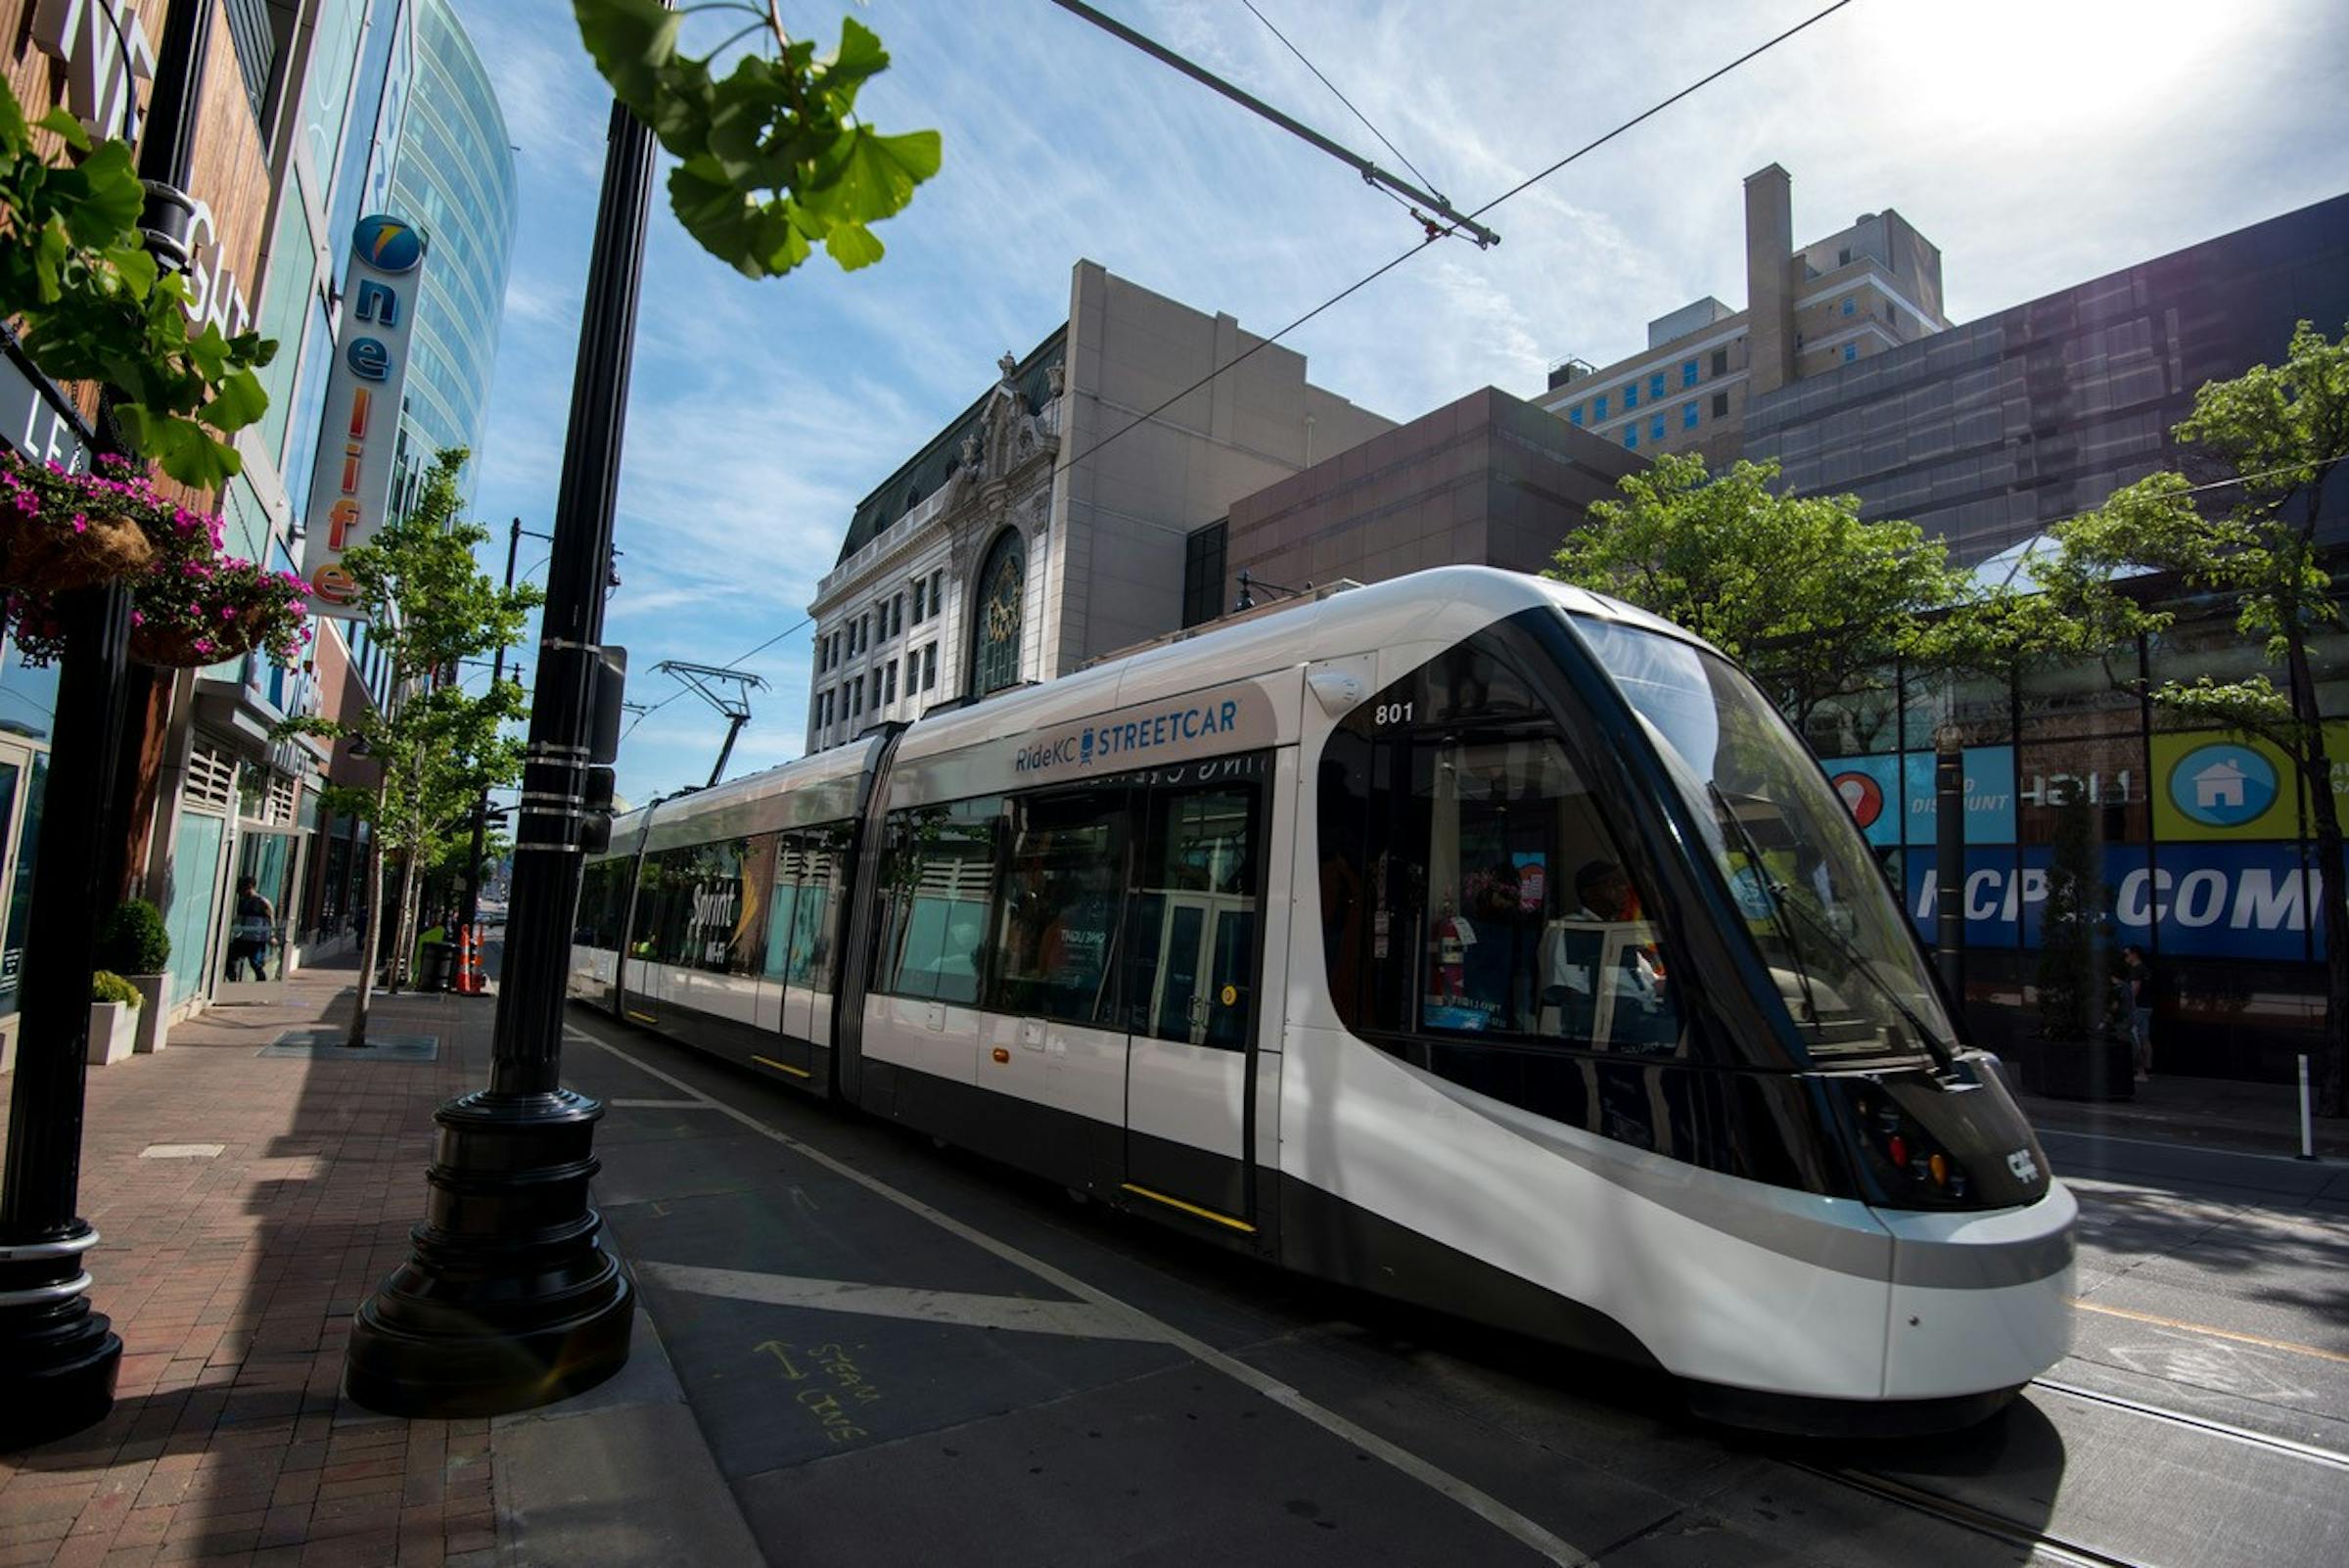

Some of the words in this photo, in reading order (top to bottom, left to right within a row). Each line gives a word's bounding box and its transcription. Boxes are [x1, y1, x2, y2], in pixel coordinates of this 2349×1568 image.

[1375, 702, 1413, 725] 801
[1016, 737, 1077, 771] RideKC
[1098, 700, 1237, 757] STREETCAR
[1911, 795, 2008, 814] DISUNT
[689, 883, 736, 939] Sprint
